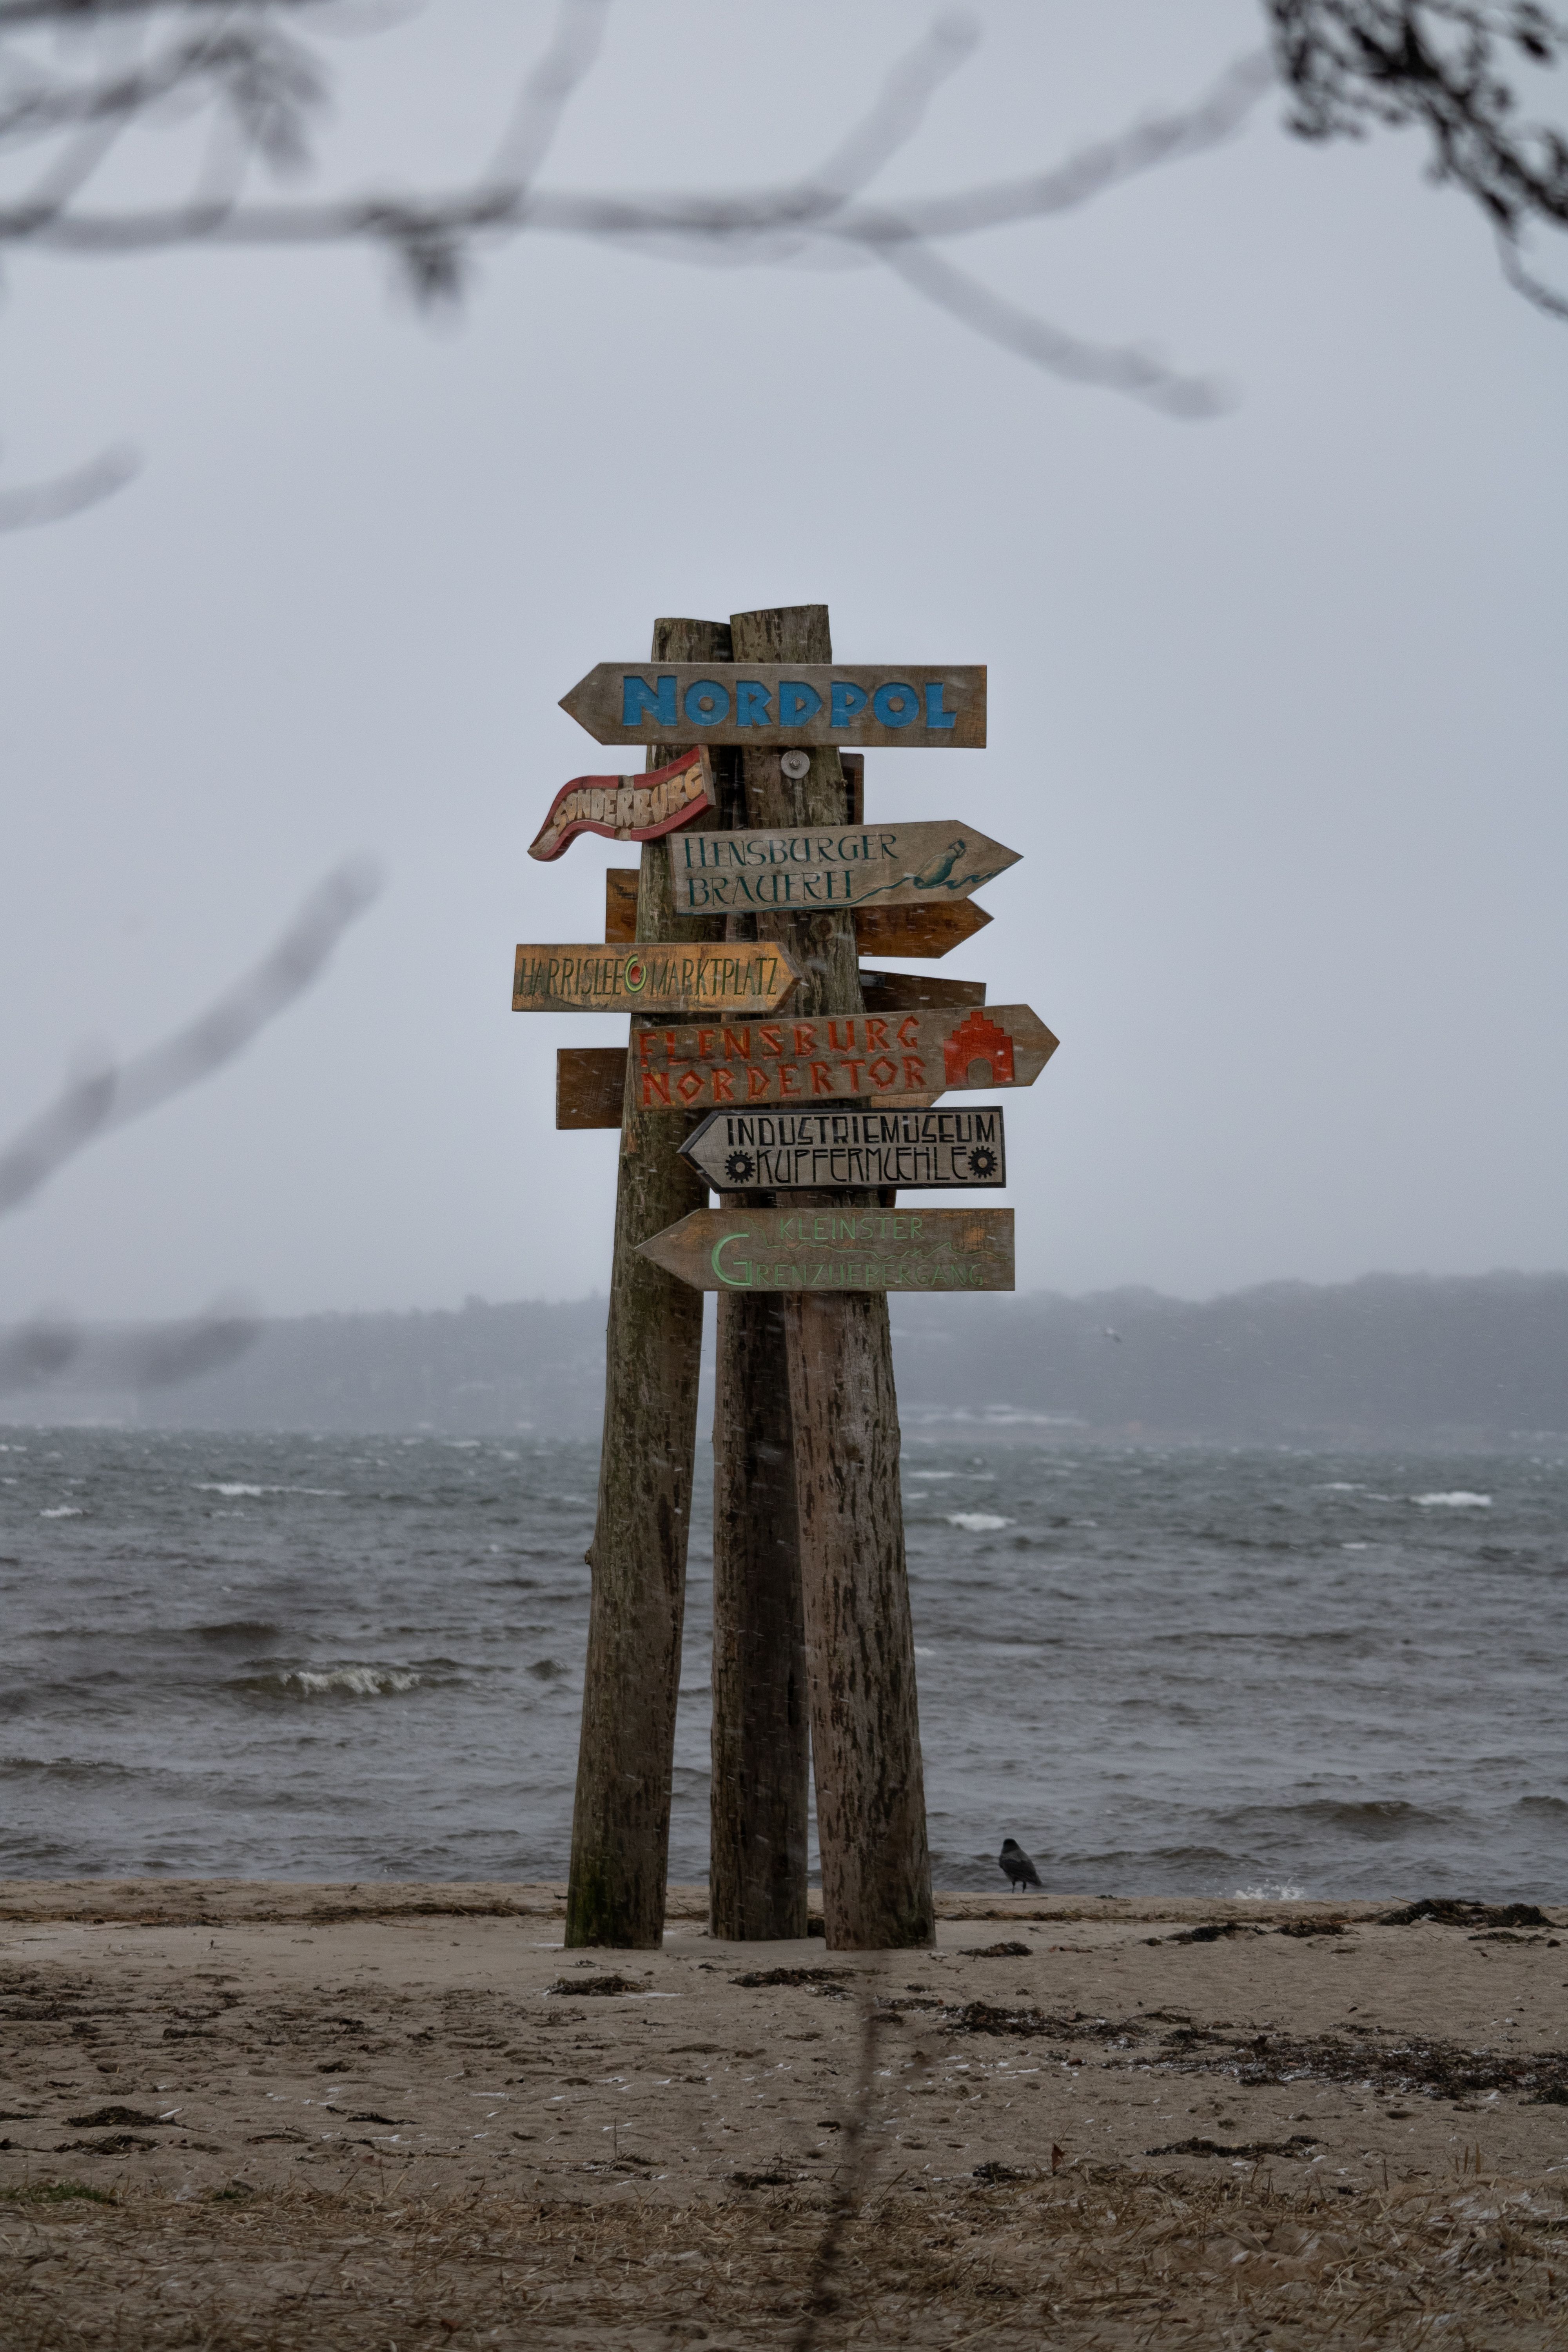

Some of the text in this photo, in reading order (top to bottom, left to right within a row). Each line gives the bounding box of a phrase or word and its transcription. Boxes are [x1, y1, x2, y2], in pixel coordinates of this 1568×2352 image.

[622, 675, 957, 728] NORDPOL
[553, 762, 703, 835] SONDERBURG
[682, 834, 899, 868] FLENSBURGER
[687, 870, 854, 907] BRAUEREI
[519, 957, 779, 996] HARRISLEE MARKTPLATZ
[638, 1015, 920, 1067] FLENSBURG
[640, 1055, 927, 1106] NORDERTOR
[727, 1114, 995, 1146] INDUSTRIEMUSEUM
[757, 1146, 968, 1184] KUPFERMUEHLE
[780, 1217, 925, 1240] KLEINSTER
[711, 1231, 984, 1287] GRENZUEBERGANG
